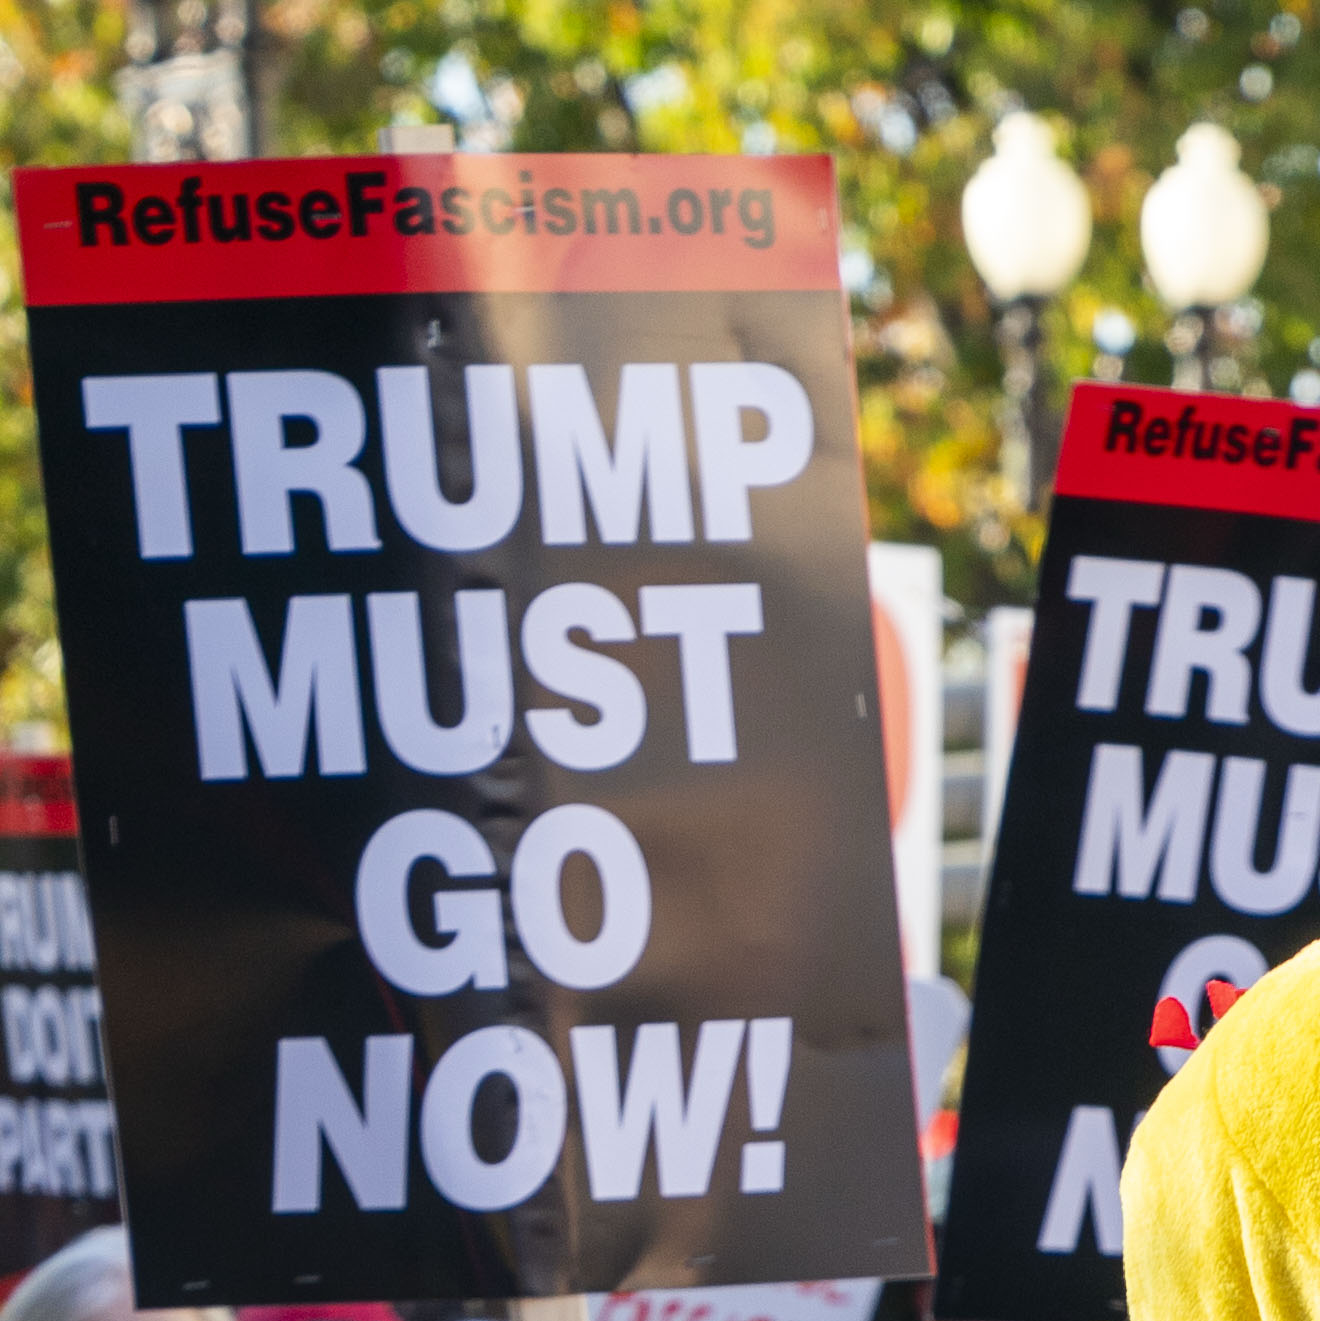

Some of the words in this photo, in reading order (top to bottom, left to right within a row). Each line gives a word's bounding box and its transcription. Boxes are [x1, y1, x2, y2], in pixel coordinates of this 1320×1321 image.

[75, 170, 777, 249] RefuseFascism.org
[81, 361, 815, 560] TRUMP
[184, 582, 765, 783] MUST
[354, 803, 653, 997] GO
[272, 1016, 793, 1213] NOW!
